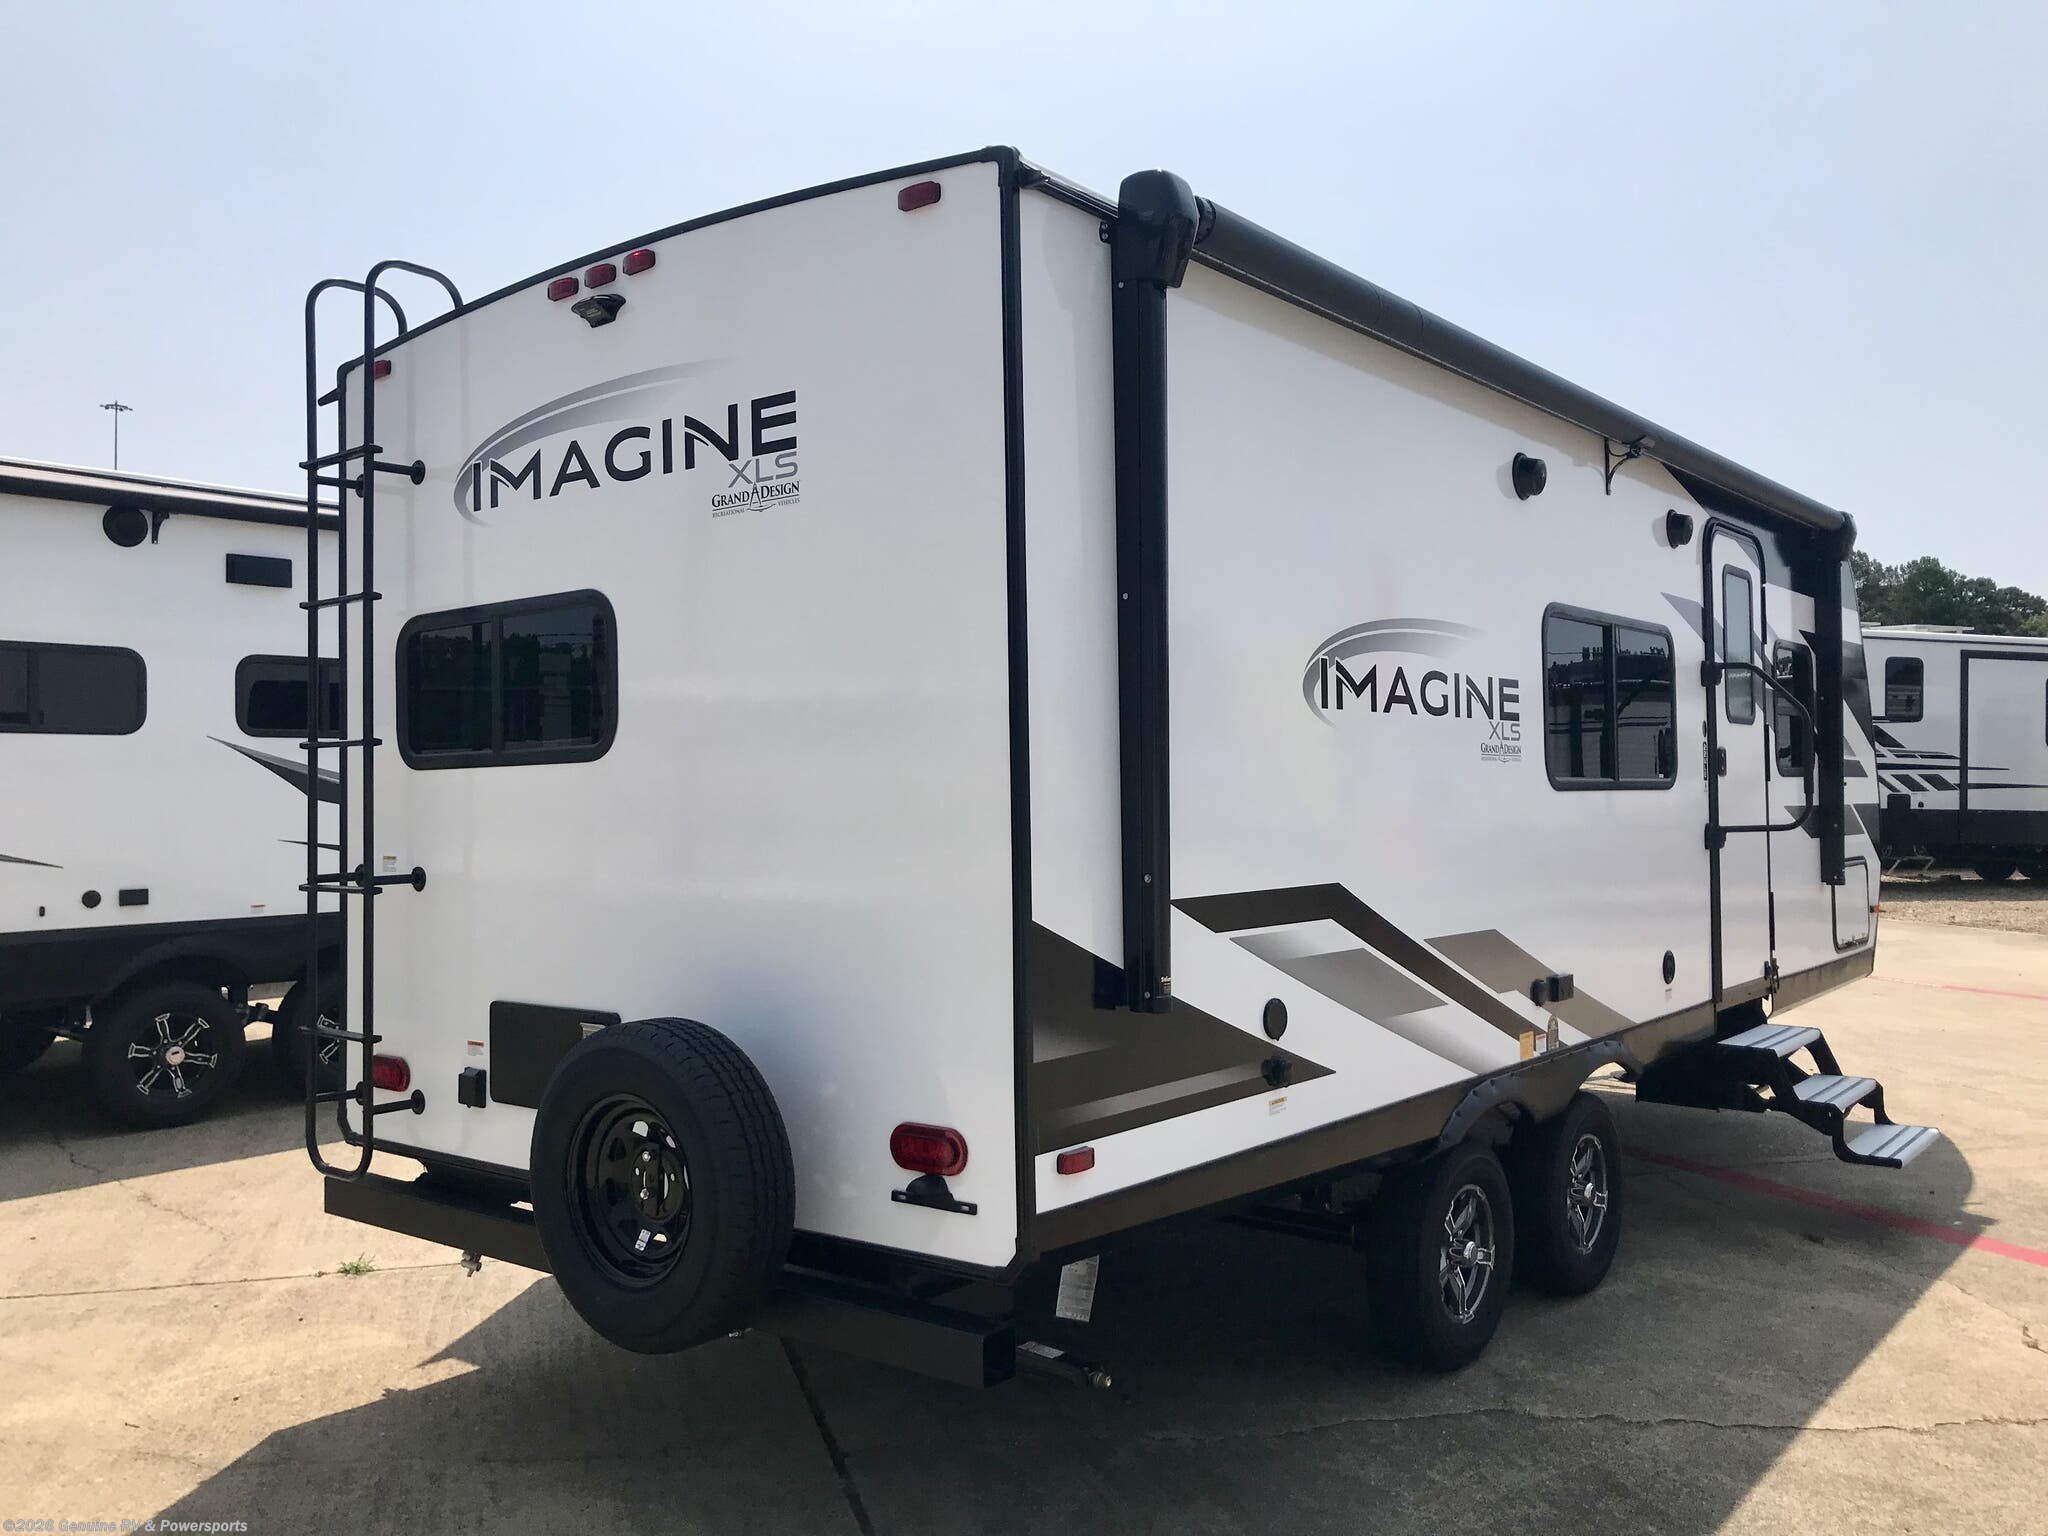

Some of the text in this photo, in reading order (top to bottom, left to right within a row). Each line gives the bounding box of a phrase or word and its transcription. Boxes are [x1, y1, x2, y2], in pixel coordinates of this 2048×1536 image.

[473, 390, 798, 512] IMAGINE
[728, 451, 798, 488] XLS
[711, 480, 800, 508] GRAND DESIGN
[1320, 657, 1520, 721] IMAGINE
[1489, 721, 1521, 741] XLS
